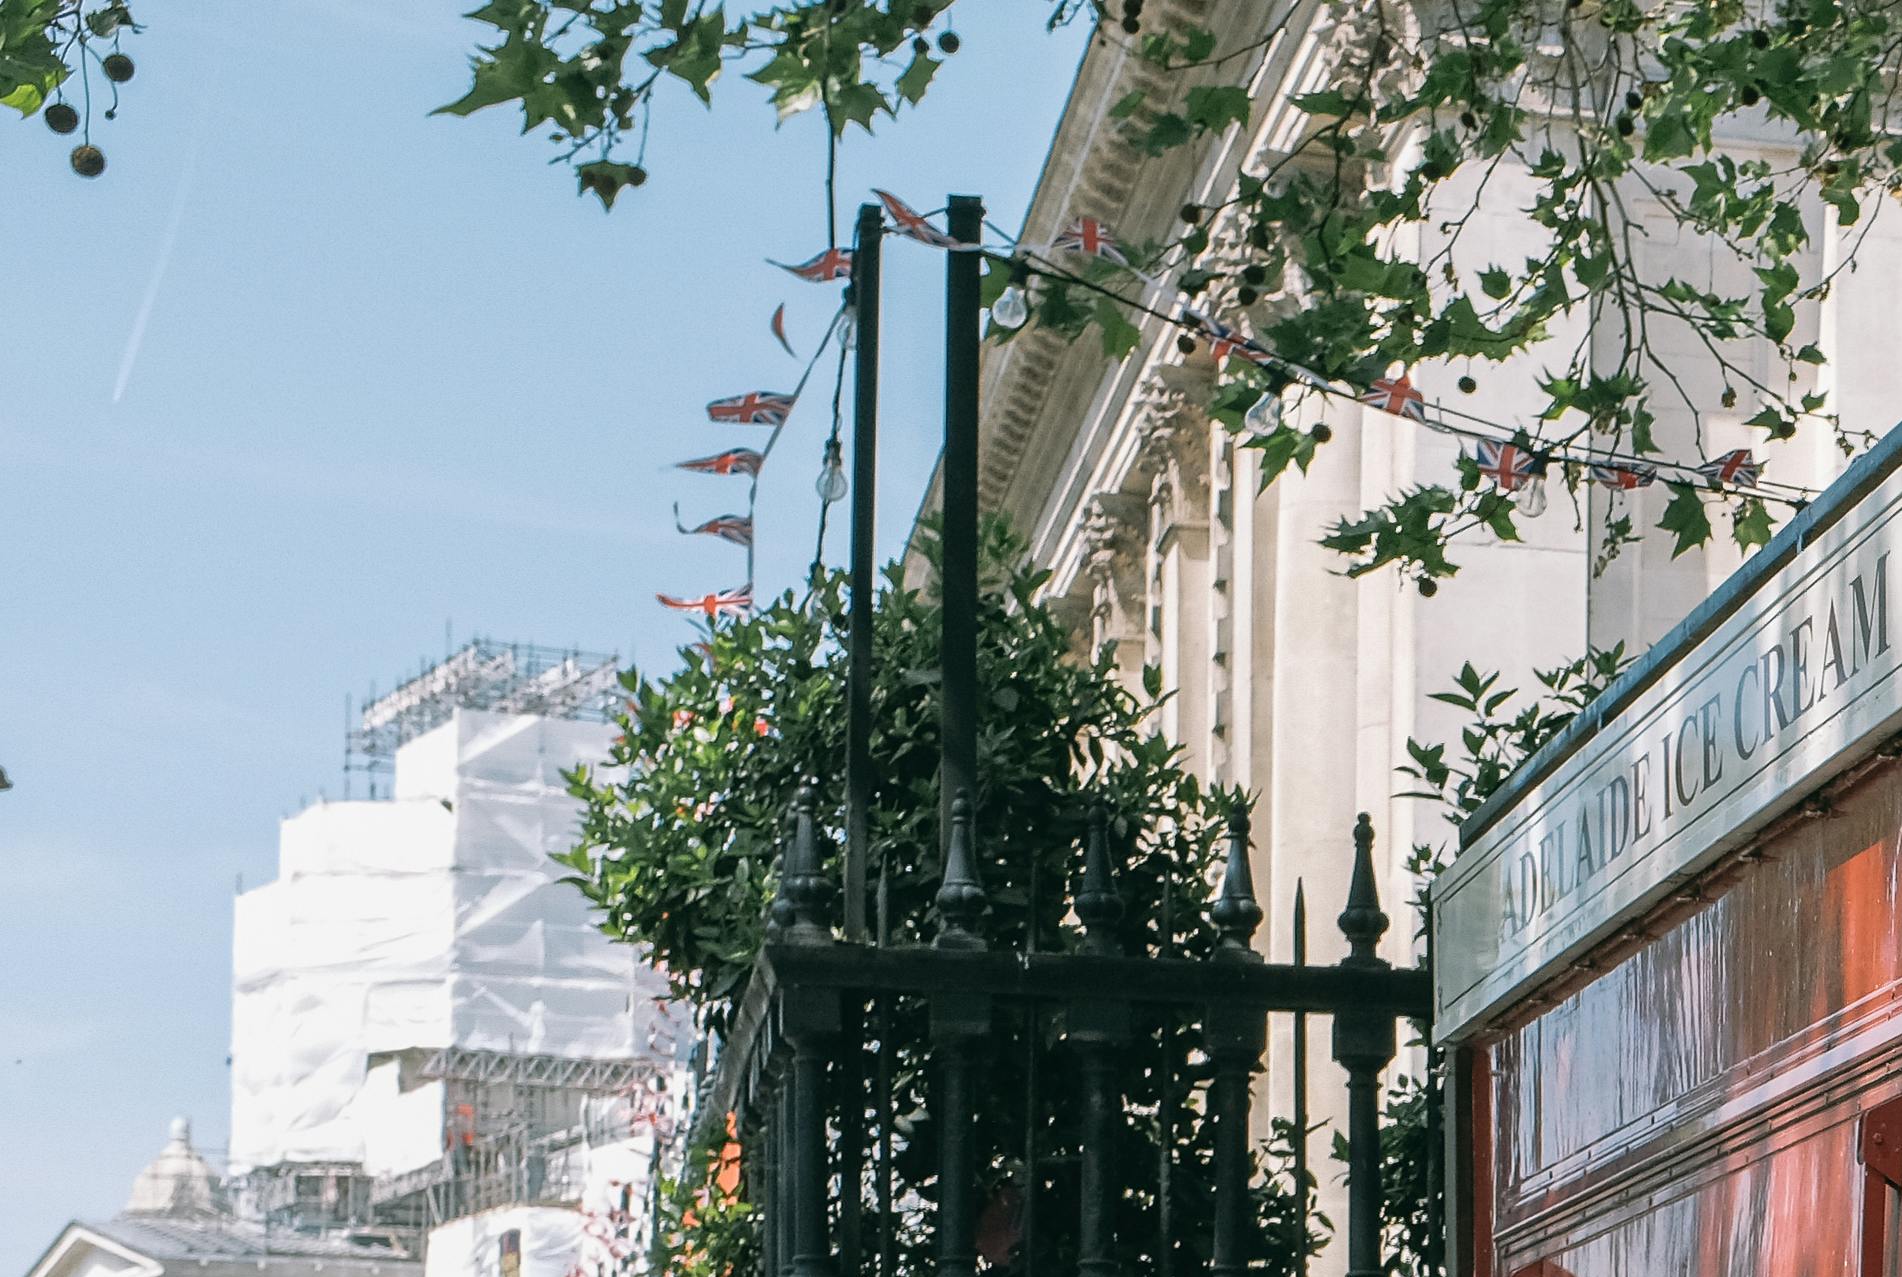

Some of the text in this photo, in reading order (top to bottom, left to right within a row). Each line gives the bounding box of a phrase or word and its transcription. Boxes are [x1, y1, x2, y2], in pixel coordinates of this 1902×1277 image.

[1501, 548, 1892, 943] ADELAIDE ICE CREAM
